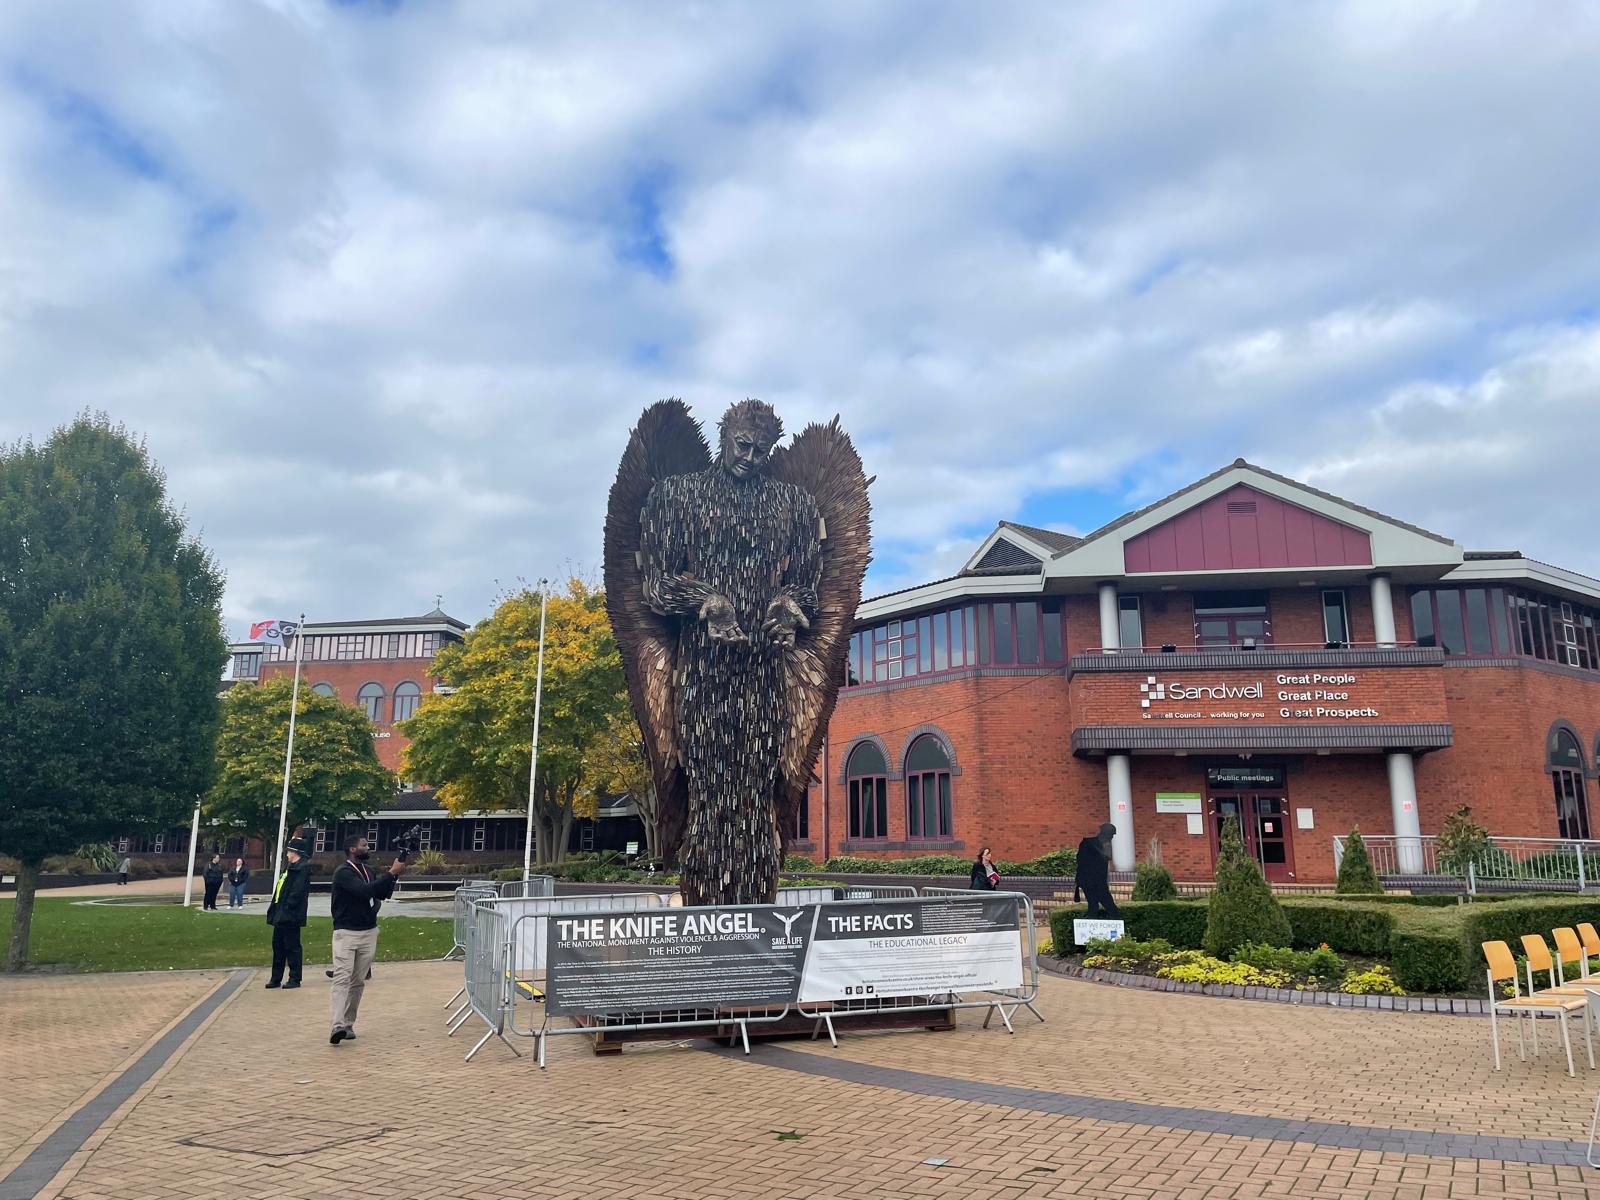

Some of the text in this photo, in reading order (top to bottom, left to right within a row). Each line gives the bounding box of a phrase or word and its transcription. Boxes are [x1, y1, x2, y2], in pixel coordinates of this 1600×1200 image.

[1276, 673, 1356, 686] Great People
[1169, 682, 1264, 700] Sandwell
[1278, 690, 1349, 701] Great Place
[1210, 712, 1239, 720] working
[1251, 712, 1265, 720] you
[1280, 707, 1380, 719] Geat Prospects
[557, 919, 604, 940] THE
[609, 916, 678, 939] KNIFE
[827, 916, 861, 933] THE
[864, 913, 914, 931] FACTS
[557, 932, 760, 949] THE NATIONAL MONUMENT AGAINST VIOLENCE & AGGRESSION
[772, 937, 786, 946] SAVE
[791, 936, 803, 945] LIFE
[869, 936, 968, 949] THE EDUCATIONAL LEGACY
[648, 945, 703, 956] THE HISTORY
